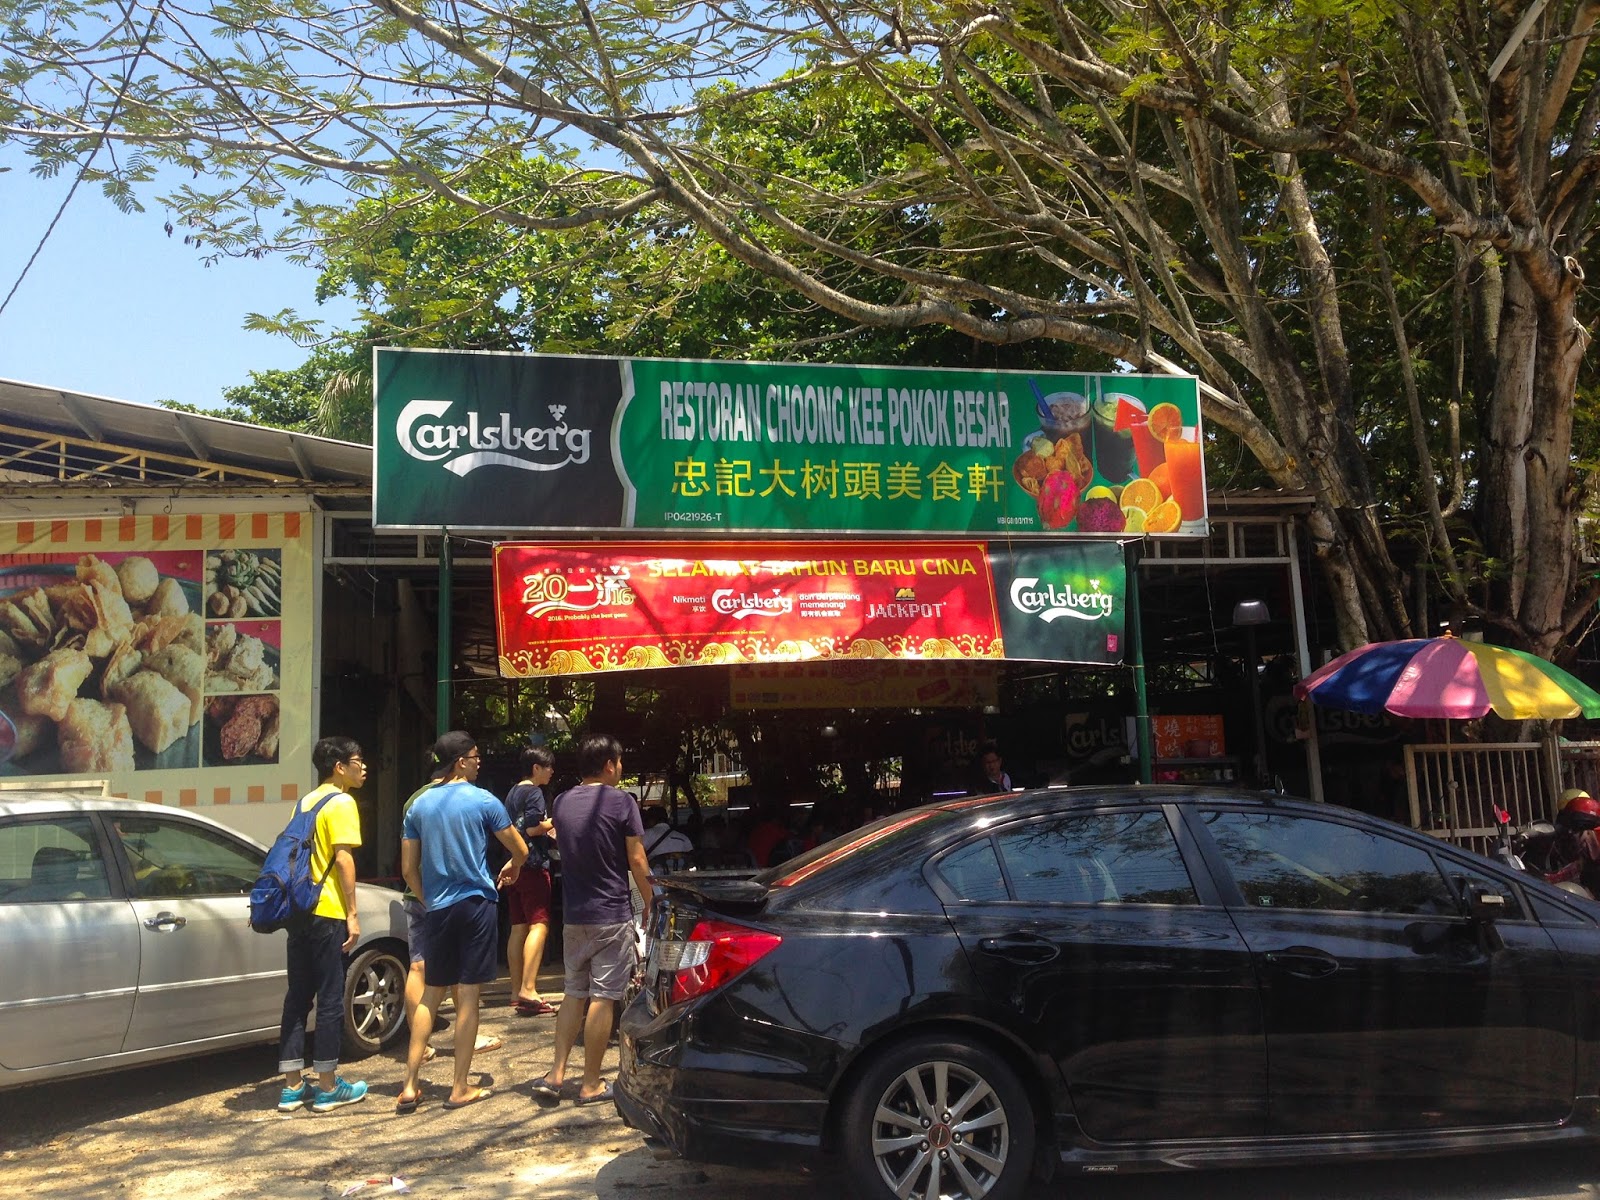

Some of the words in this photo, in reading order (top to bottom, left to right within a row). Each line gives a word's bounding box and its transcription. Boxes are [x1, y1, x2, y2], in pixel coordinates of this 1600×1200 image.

[660, 381, 761, 441] RESTORAN
[766, 384, 845, 444] CHOONG
[849, 387, 885, 445] KEE
[888, 388, 951, 446] POKOK
[953, 390, 1011, 448] BESAR
[396, 400, 592, 477] Carlsberg
[672, 456, 1004, 502] 忠記大树頭美食軒
[854, 559, 917, 576] BARU
[925, 558, 977, 575] CINA
[673, 595, 706, 604] Nikmati
[711, 589, 793, 620] Carlsberg
[866, 603, 943, 618] JACKPOT
[1010, 578, 1113, 623] Carlsberg
